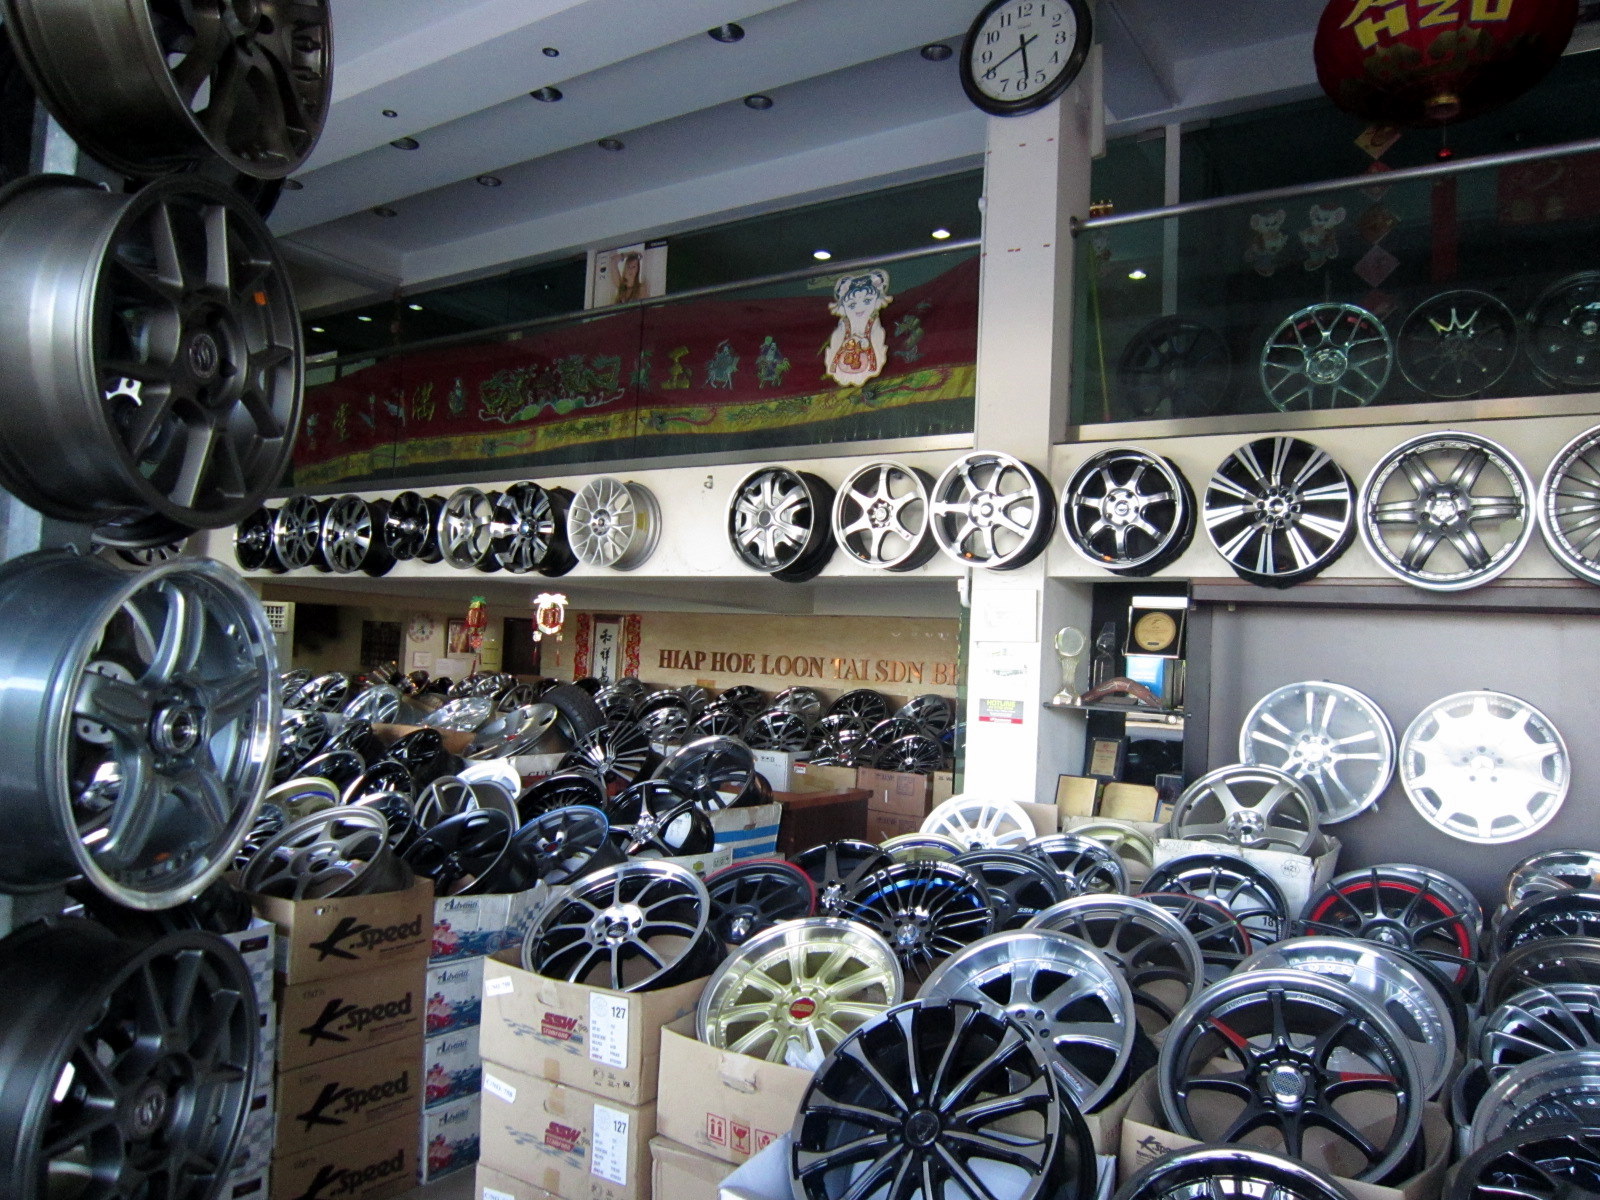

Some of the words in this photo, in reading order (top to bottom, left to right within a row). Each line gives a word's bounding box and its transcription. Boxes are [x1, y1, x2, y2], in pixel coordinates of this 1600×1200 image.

[1018, 3, 1033, 19] 12
[1041, 4, 1046, 17] 1
[1000, 13, 1012, 28] 11
[1052, 13, 1062, 28] 2
[986, 30, 1000, 45] 10
[1055, 31, 1066, 45] 3
[982, 51, 993, 64] 9
[1049, 51, 1059, 64] 4
[1035, 69, 1046, 84] 5
[1000, 79, 1009, 92] 7
[1017, 77, 1027, 92] 6
[658, 648, 707, 670] HIAP
[710, 652, 756, 674] HOE
[760, 653, 825, 679] LOON
[830, 657, 870, 681] TAI
[874, 659, 925, 685] SDN
[610, 1006, 626, 1019] 127
[613, 1120, 627, 1134] 127
